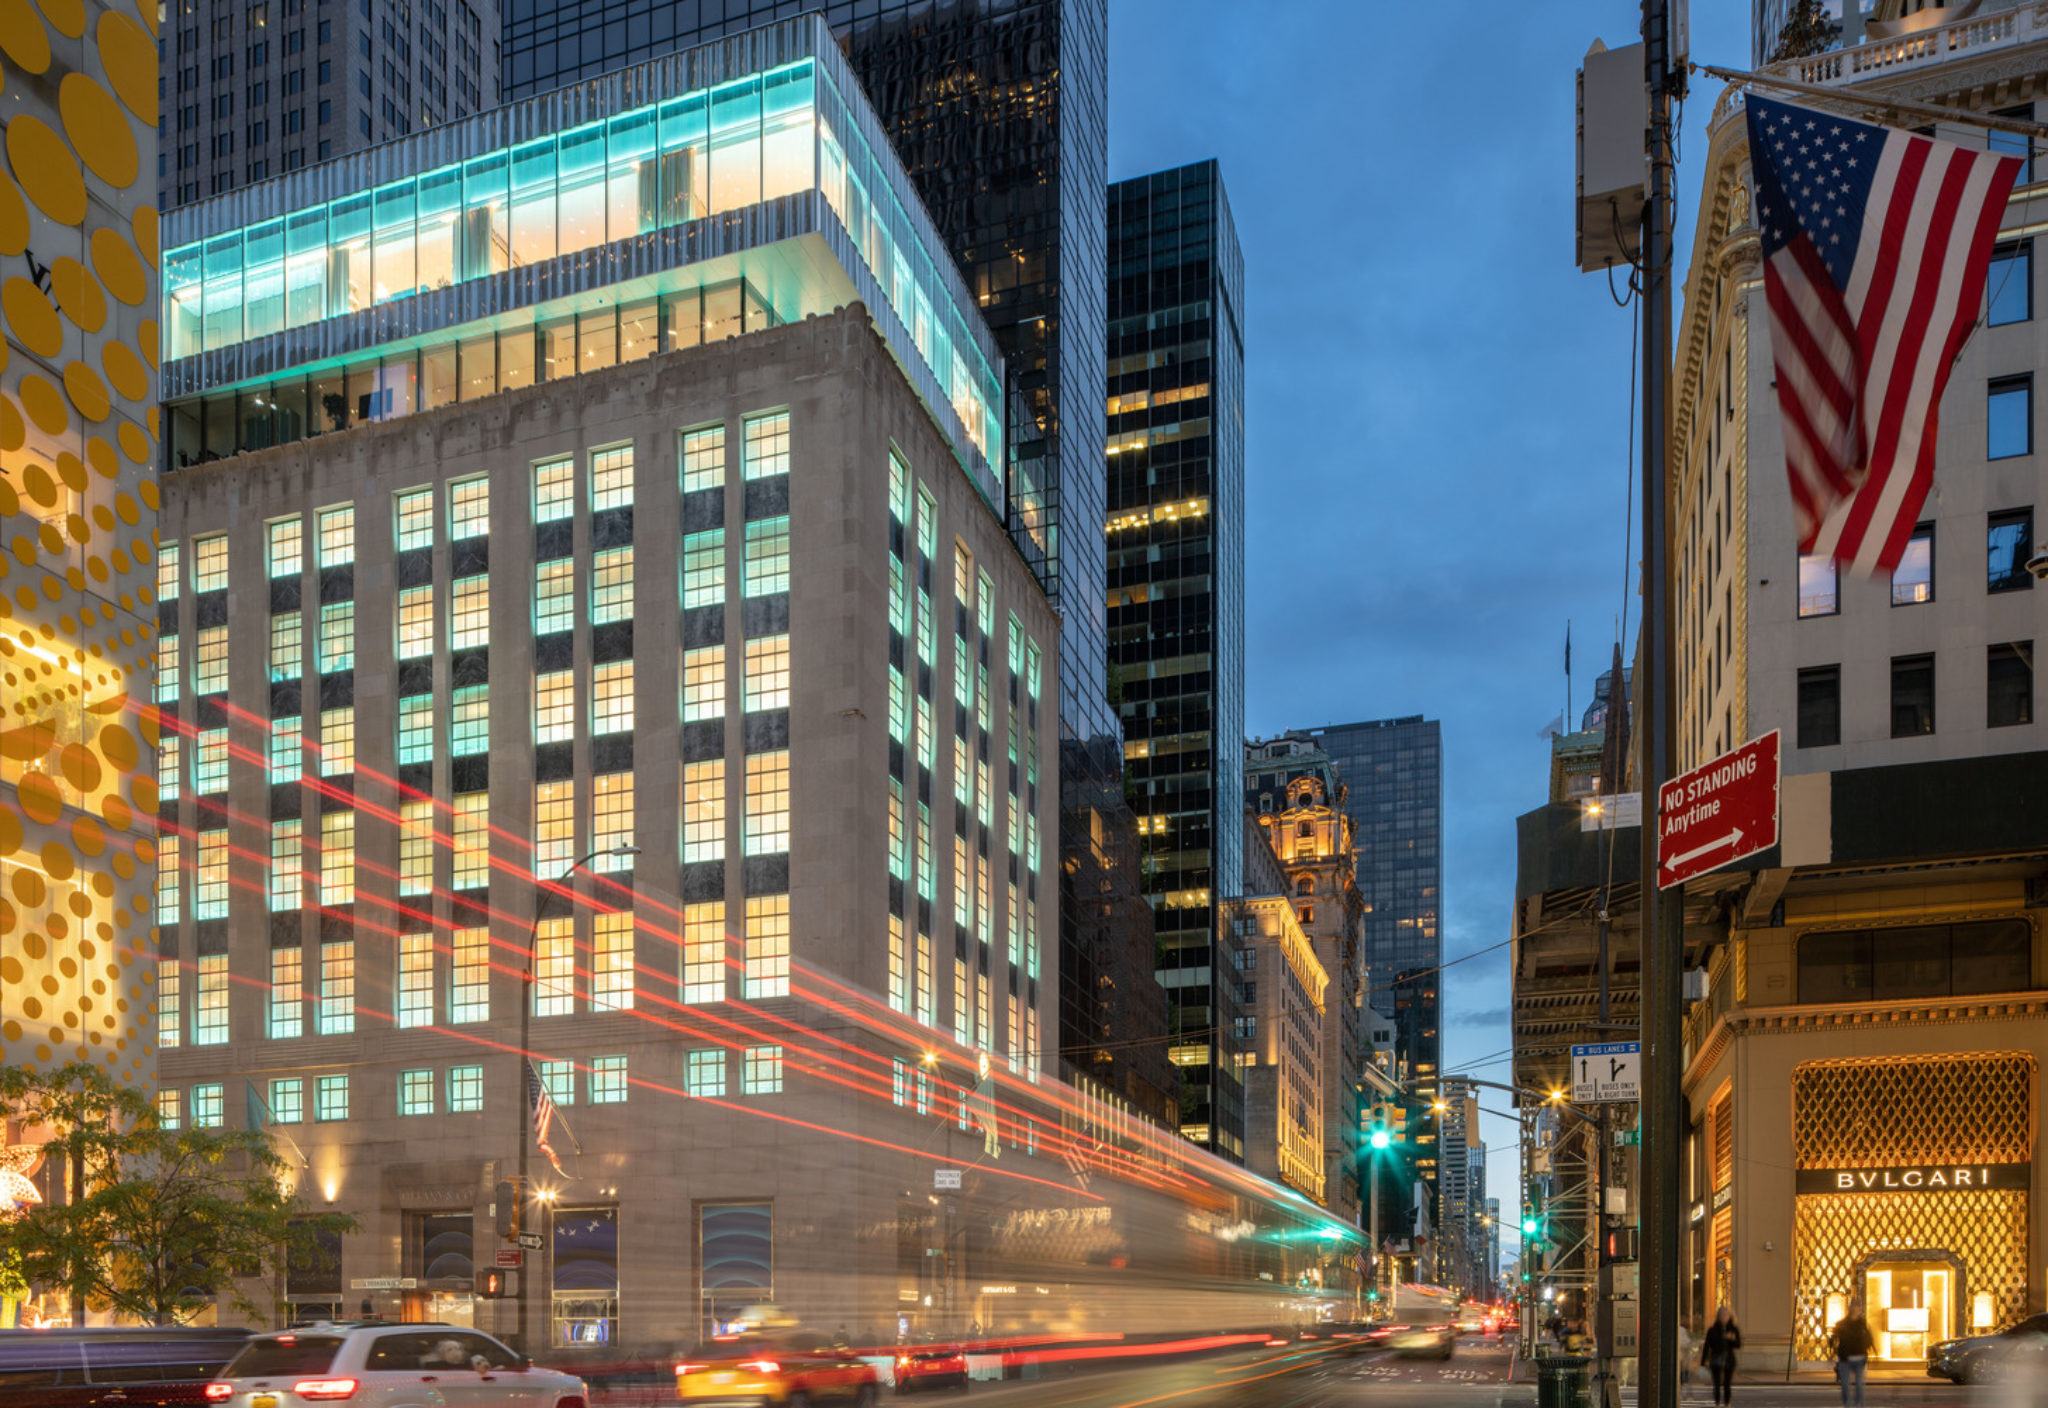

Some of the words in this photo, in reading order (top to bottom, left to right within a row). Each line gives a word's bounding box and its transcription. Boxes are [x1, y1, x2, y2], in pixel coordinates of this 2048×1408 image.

[1665, 788, 1684, 812] NO
[1687, 753, 1757, 802] STANDING
[1665, 799, 1720, 837] Anytime
[1604, 1045, 1625, 1053] LANES
[1621, 1082, 1635, 1090] ONLY
[1837, 1168, 1988, 1188] BVLGARI
